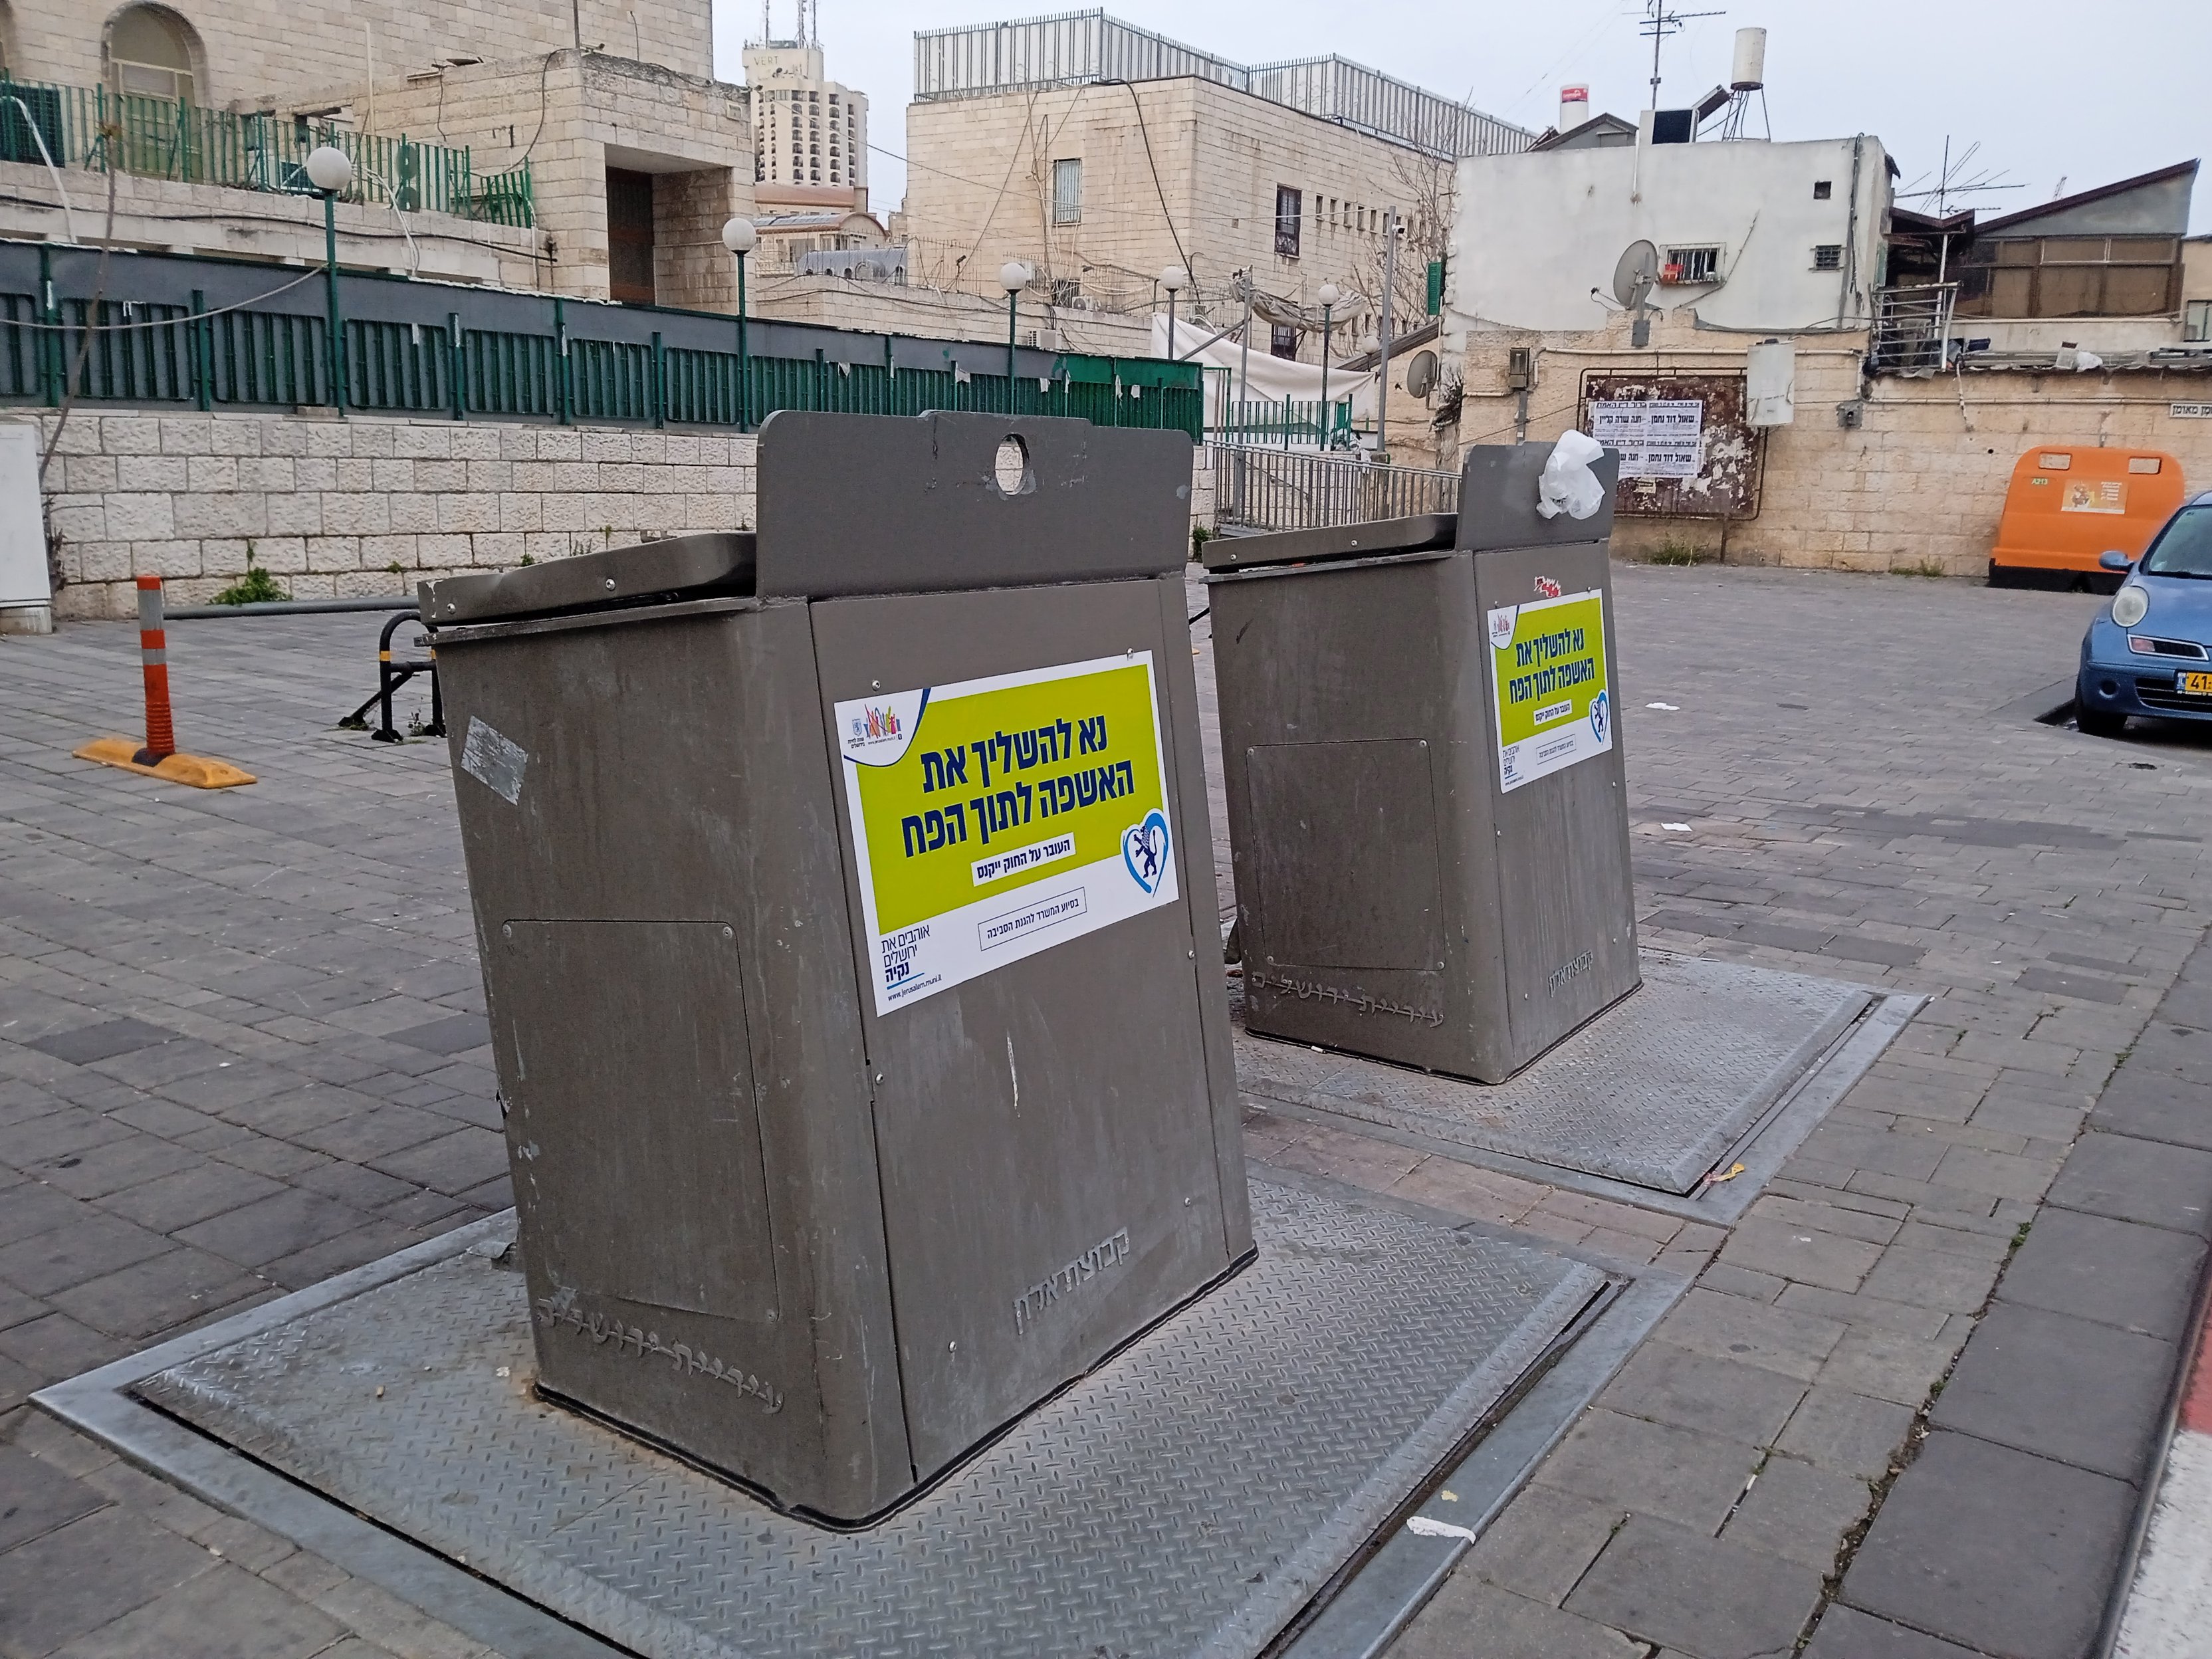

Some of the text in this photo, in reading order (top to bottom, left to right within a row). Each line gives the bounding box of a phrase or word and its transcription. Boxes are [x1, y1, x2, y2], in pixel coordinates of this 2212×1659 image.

[754, 56, 778, 65] VERT
[1652, 415, 1664, 425] נחמן
[1678, 413, 1694, 423] שאול
[1648, 454, 1662, 463] נחמן
[1675, 453, 1692, 462] שאול
[1516, 628, 1584, 667] נא להשליך את
[1509, 657, 1595, 704] האשפה לתוך הפח
[920, 715, 1107, 793] נא להשליך את
[901, 760, 1135, 858] האשפה לתוך הפח
[977, 839, 1071, 879] העובר על החוק ייקנס
[987, 899, 1079, 939] בסיוע המשרד להגנת הסביבה
[881, 925, 930, 953] אוהבים את
[883, 944, 917, 968] ירושלים
[885, 962, 909, 982] נקיה
[1252, 971, 1349, 1004] ירושלים
